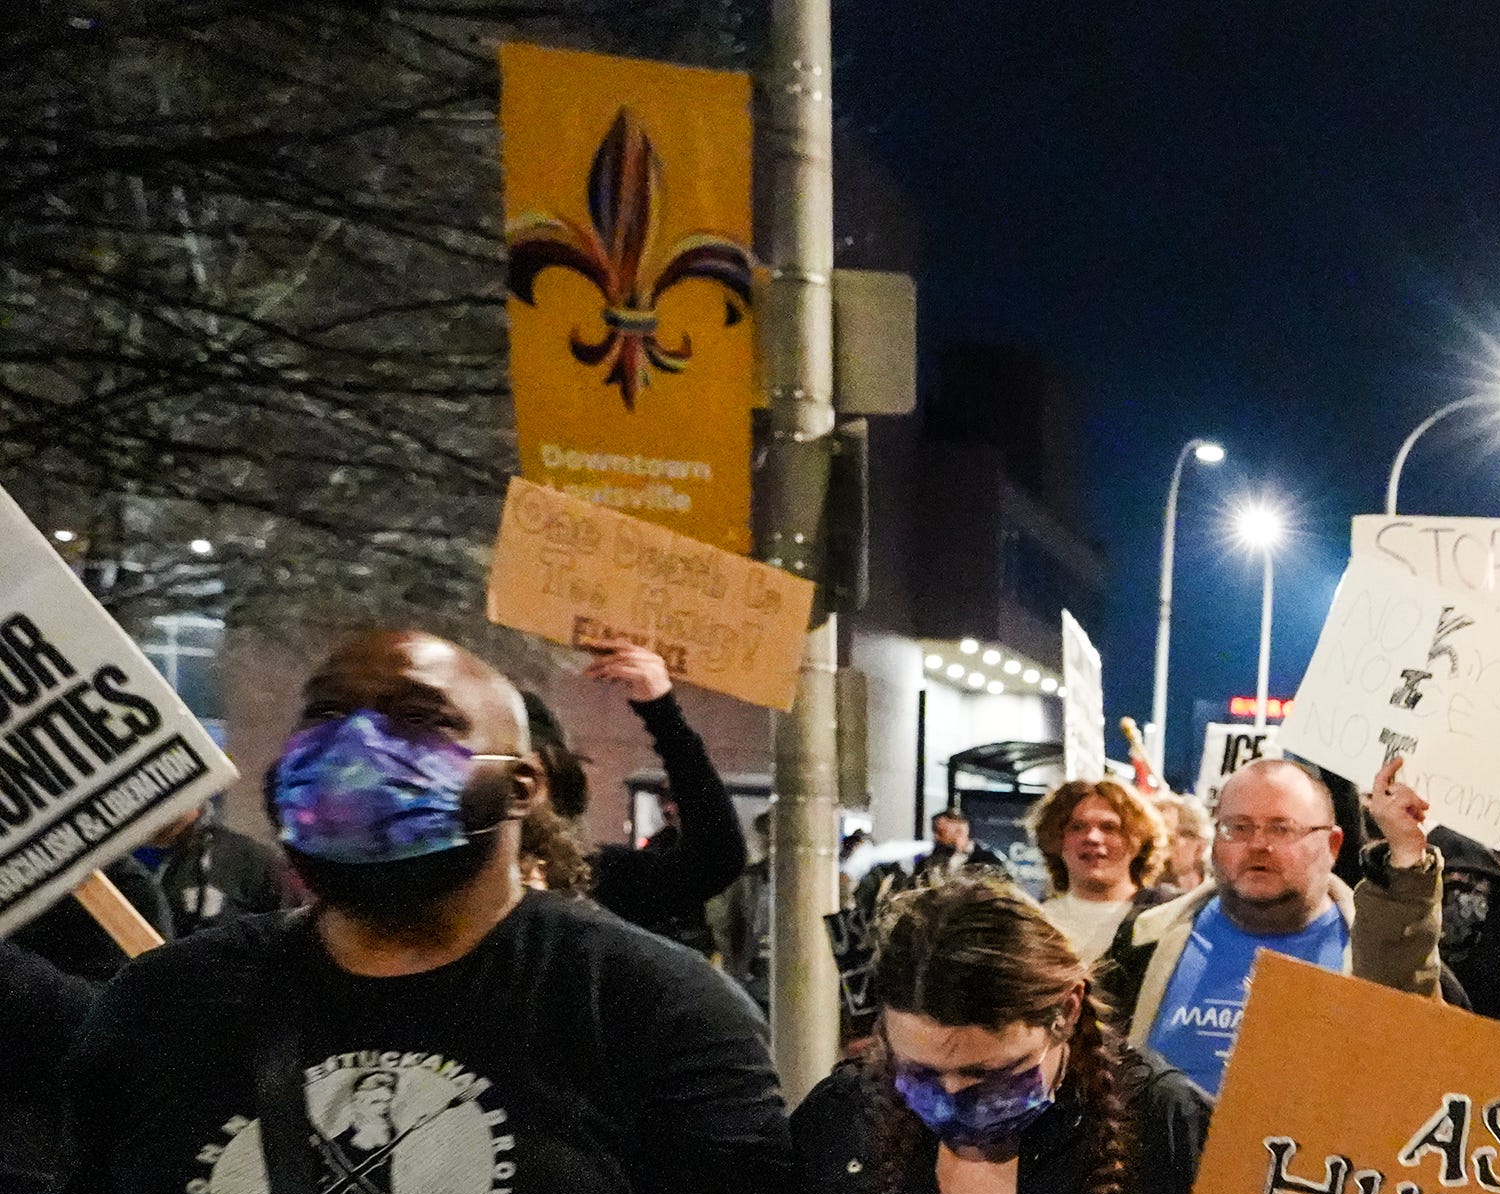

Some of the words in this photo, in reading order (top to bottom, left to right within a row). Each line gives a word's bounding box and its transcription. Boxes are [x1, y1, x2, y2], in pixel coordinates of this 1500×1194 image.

[541, 444, 712, 482] Downtown
[0, 612, 77, 727] UR
[0, 662, 162, 840] UNITIES
[74, 810, 103, 844] &
[97, 743, 199, 830] LIBERATION
